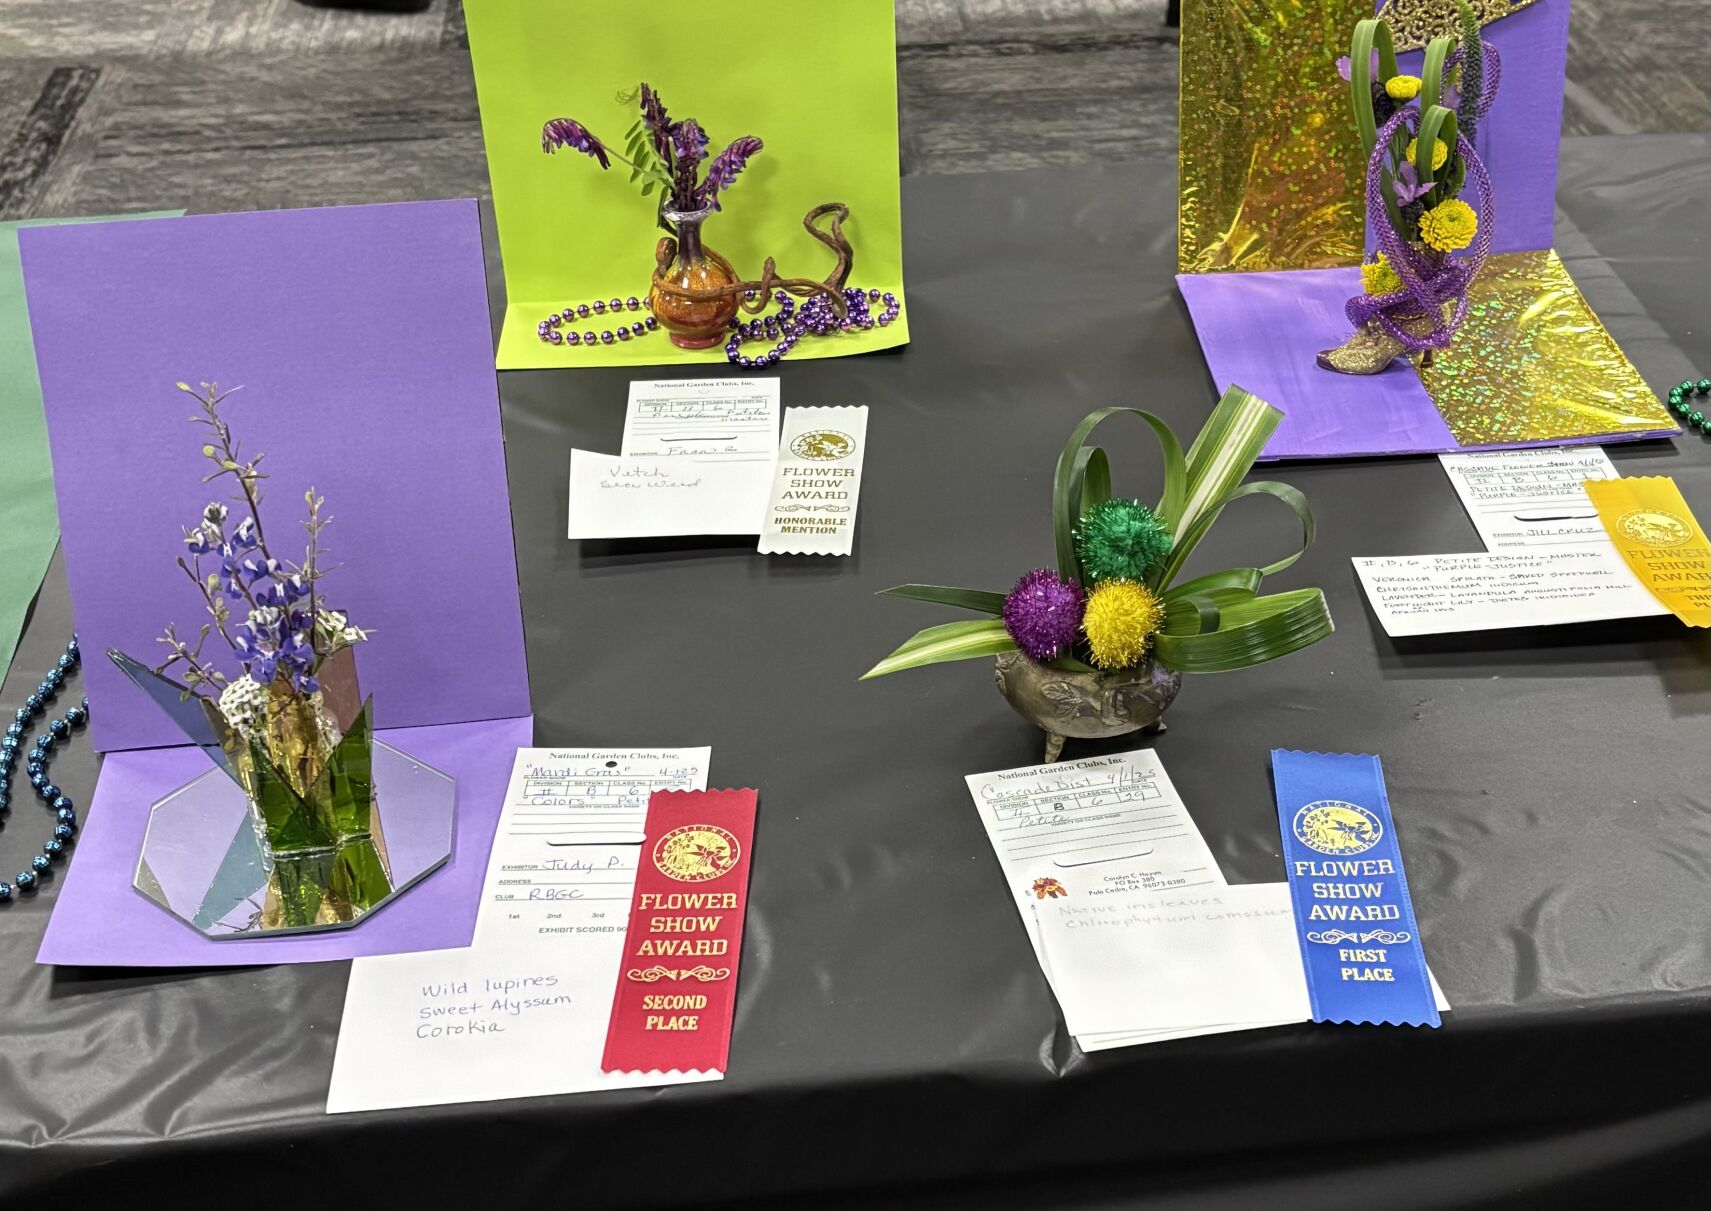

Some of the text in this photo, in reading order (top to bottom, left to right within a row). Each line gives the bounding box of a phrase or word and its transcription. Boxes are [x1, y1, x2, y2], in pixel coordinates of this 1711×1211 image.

[782, 467, 856, 476] FLOWER
[790, 480, 844, 488] SHOW
[781, 491, 848, 500] AWARD
[774, 517, 848, 526] HONORABLE
[780, 526, 837, 534] MENTION
[1626, 548, 1711, 559] FLOWER
[1648, 561, 1705, 570] SHOW
[630, 752, 660, 760] Clubs,
[998, 757, 1126, 781] National Garden Clubs, Inc.
[629, 786, 639, 796] 6
[1054, 802, 1064, 810] B
[1126, 792, 1145, 801] 29
[542, 860, 592, 874] Judy
[1294, 859, 1396, 876] FLOWER
[1313, 882, 1384, 899] SHOW
[638, 892, 738, 910] FLOWER
[1309, 904, 1399, 920] AWARD
[650, 916, 722, 933] SHOW
[636, 939, 728, 956] AWARD
[1340, 949, 1388, 962] FIRST
[1342, 968, 1394, 981] PLACE
[422, 974, 559, 998] Wild lupines
[491, 994, 572, 1016] Alyssum
[642, 995, 708, 1010] SECOND
[416, 1020, 504, 1039] Corokia
[646, 1016, 698, 1031] PLACE
